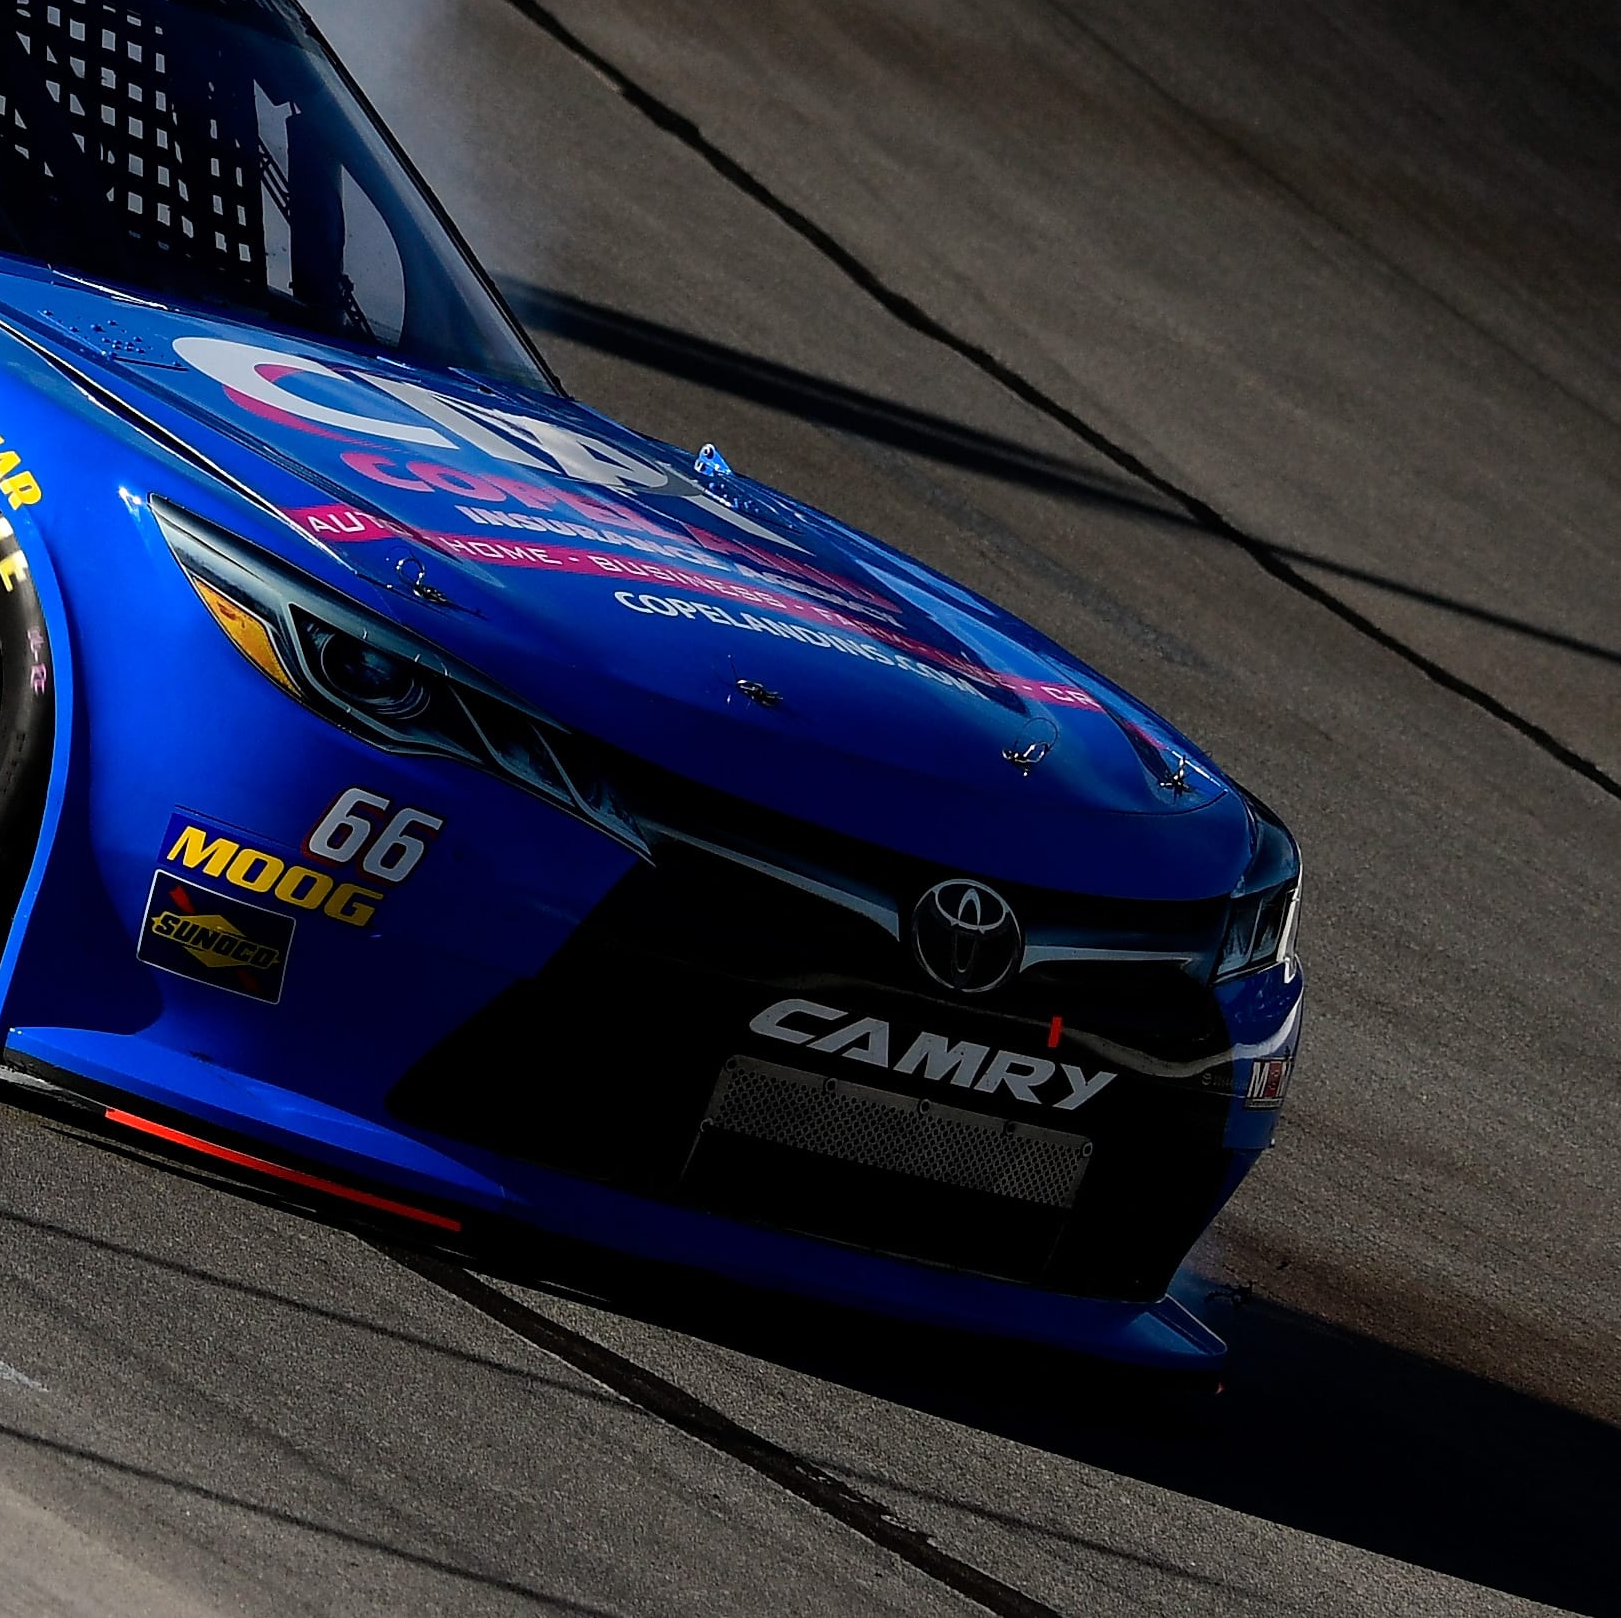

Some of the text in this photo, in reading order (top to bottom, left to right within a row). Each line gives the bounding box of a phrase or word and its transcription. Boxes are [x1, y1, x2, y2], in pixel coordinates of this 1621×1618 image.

[439, 536, 563, 567] HOME
[586, 554, 787, 610] BUSINESS
[455, 504, 731, 573] INSURANCE
[166, 825, 384, 927] MOOG
[305, 786, 444, 884] 66
[152, 910, 282, 970] SUNOCO
[749, 998, 1118, 1111] CAMRY
